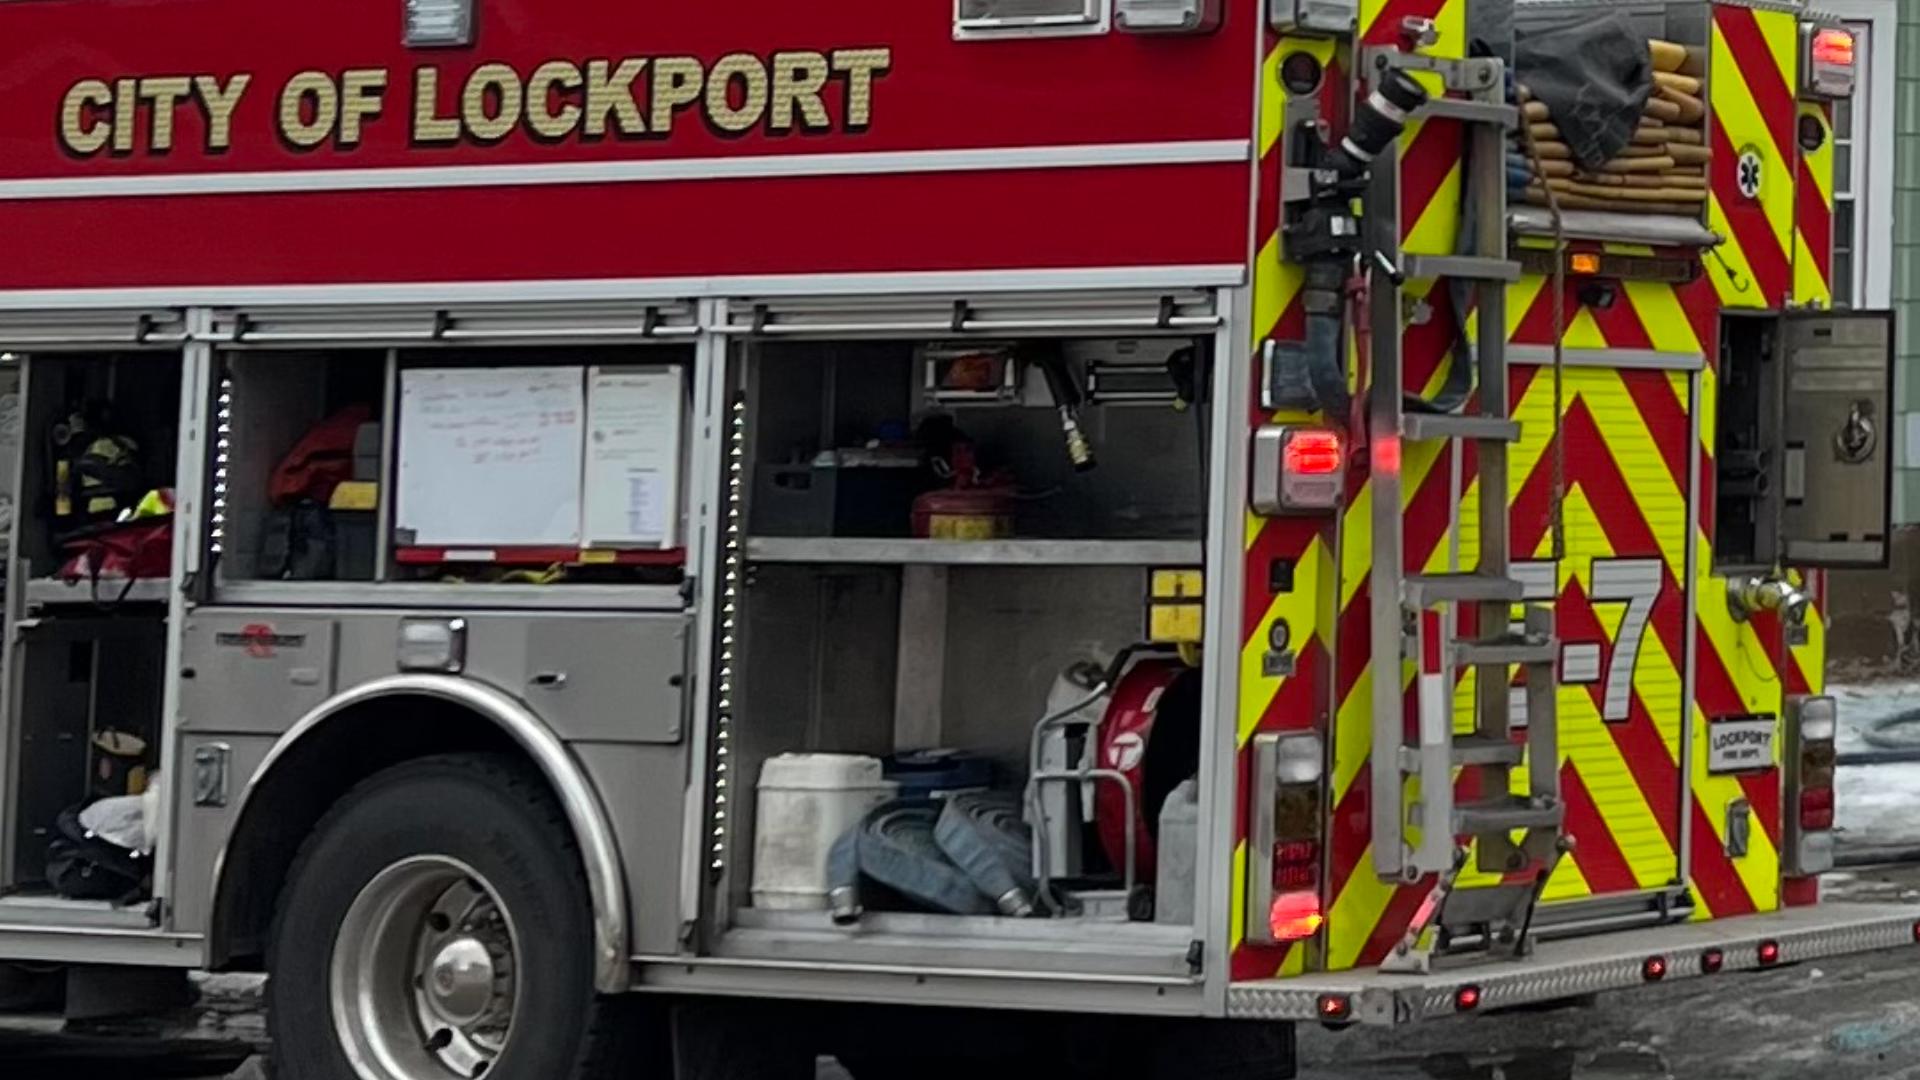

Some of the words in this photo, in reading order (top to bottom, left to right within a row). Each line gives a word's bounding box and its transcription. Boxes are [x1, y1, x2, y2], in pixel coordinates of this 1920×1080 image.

[60, 74, 251, 154] CITY
[279, 69, 388, 147] OF
[413, 48, 891, 144] LOCKPORT
